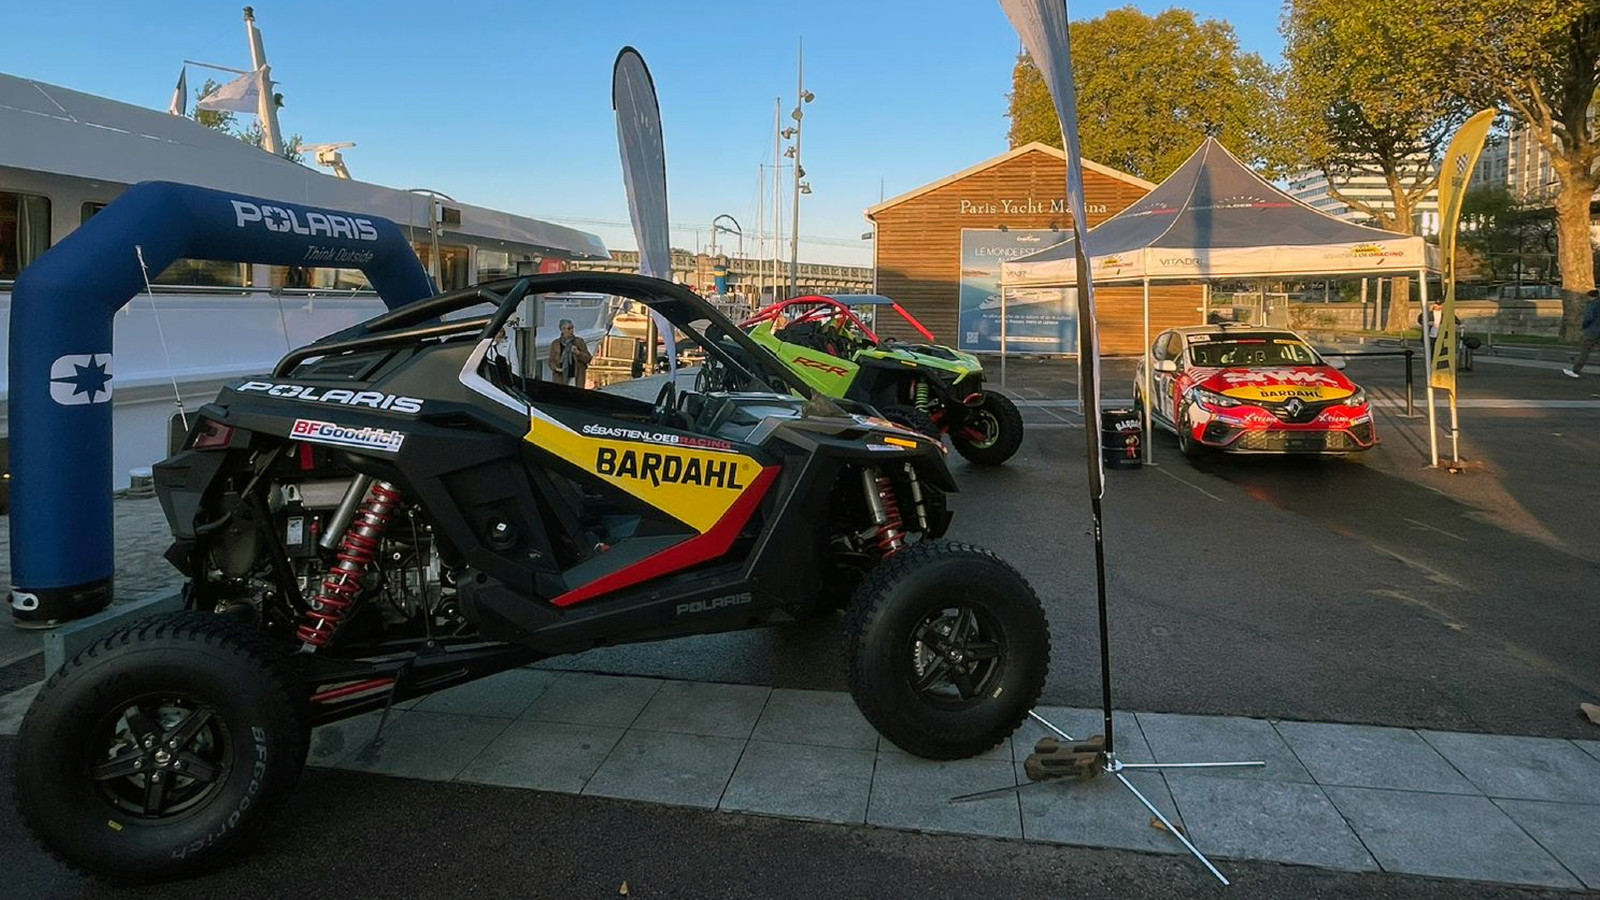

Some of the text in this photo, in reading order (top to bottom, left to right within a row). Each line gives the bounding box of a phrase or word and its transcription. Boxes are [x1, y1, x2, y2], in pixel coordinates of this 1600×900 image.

[960, 200, 997, 214] Paris
[1001, 197, 1043, 214] Yacht
[1050, 199, 1107, 214] Maina
[231, 200, 378, 241] POLARIS
[304, 246, 374, 263] Think Outside
[986, 247, 1019, 256] MONDE
[237, 381, 425, 414] POLARIS
[1261, 390, 1323, 399] BARDAHL
[293, 421, 402, 446] BFGoodrich
[596, 447, 743, 490] BARDAHL
[676, 592, 752, 616] POLARIS
[171, 726, 268, 860] BFGoodrich
